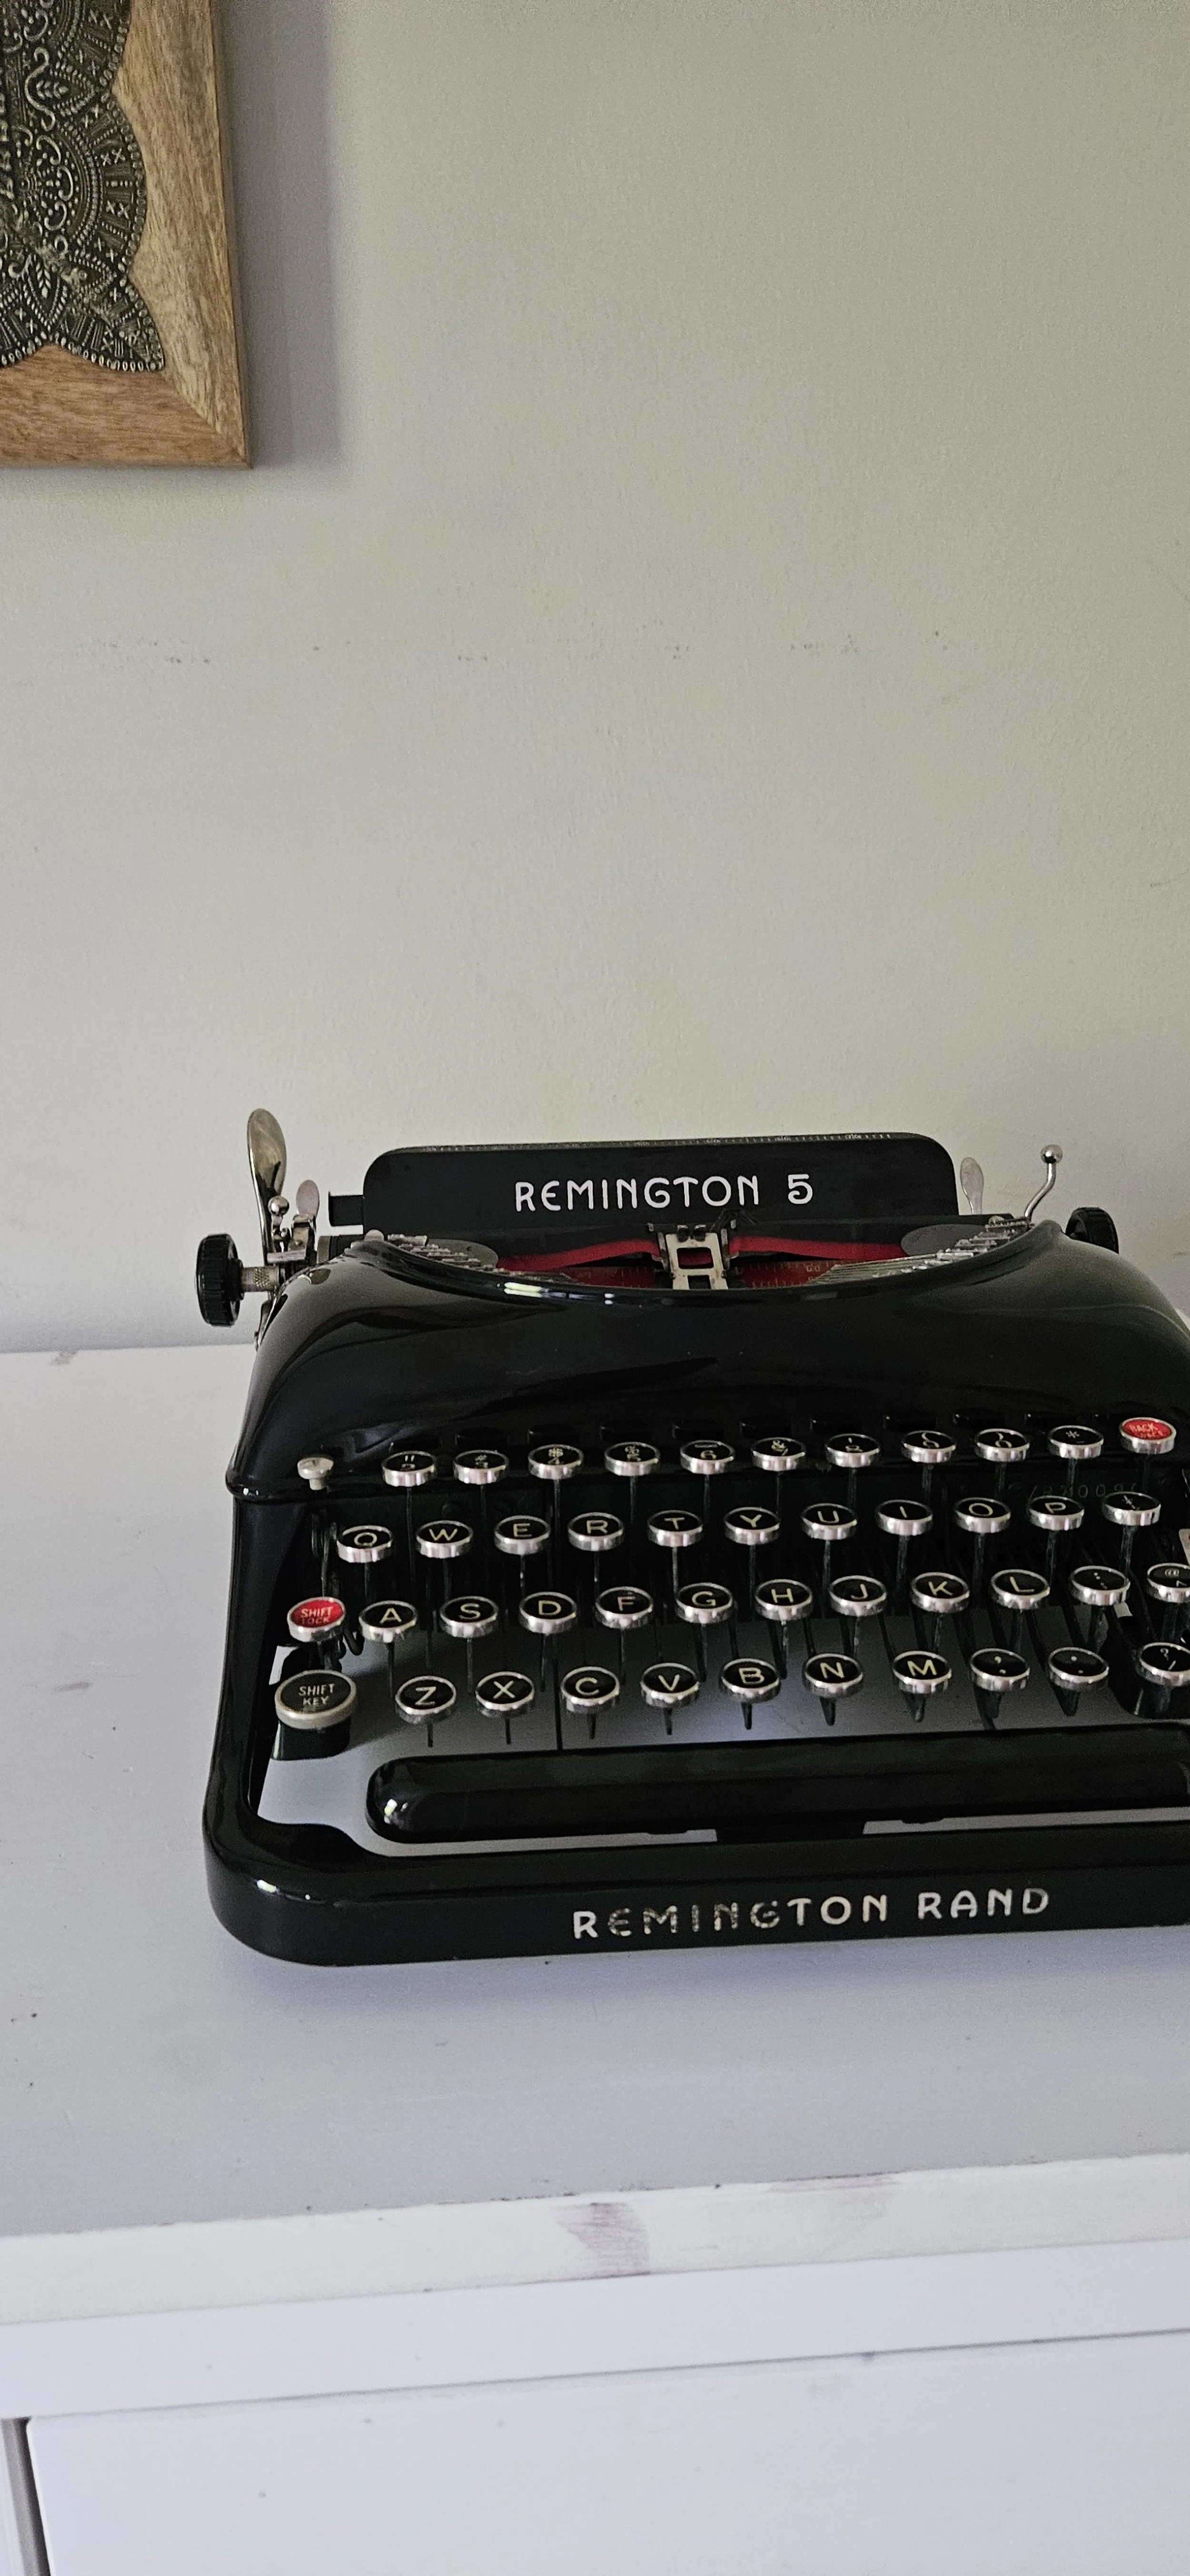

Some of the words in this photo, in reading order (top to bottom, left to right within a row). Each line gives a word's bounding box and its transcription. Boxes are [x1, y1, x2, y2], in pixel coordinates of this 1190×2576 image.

[515, 1175, 759, 1212] REMINGTON
[788, 1174, 813, 1204] 5
[900, 1506, 907, 1518] I
[968, 1502, 993, 1517] O
[1045, 1502, 1066, 1513] P
[664, 1517, 684, 1530] T
[739, 1514, 764, 1528] Y
[817, 1510, 840, 1524] U
[513, 1523, 530, 1537] E
[586, 1520, 608, 1534] R
[429, 1529, 458, 1542] W
[851, 1584, 868, 1599] J
[928, 1581, 952, 1596] K
[1009, 1576, 1035, 1593] L
[617, 1596, 635, 1611] F
[691, 1591, 716, 1607] G
[771, 1588, 793, 1604] H
[301, 1606, 334, 1618] SHIFT
[460, 1603, 481, 1619] S
[538, 1600, 561, 1615] D
[380, 1608, 402, 1623] A
[739, 1667, 764, 1683] B
[820, 1662, 844, 1678] N
[907, 1659, 937, 1676] M
[298, 1683, 335, 1697] SHIFT
[494, 1681, 515, 1699] X
[575, 1677, 599, 1695] C
[658, 1674, 680, 1691] V
[302, 1695, 330, 1706] KEY
[415, 1686, 436, 1705] Z
[573, 1894, 888, 1939] REMINGTON
[918, 1889, 1049, 1919] RAND
